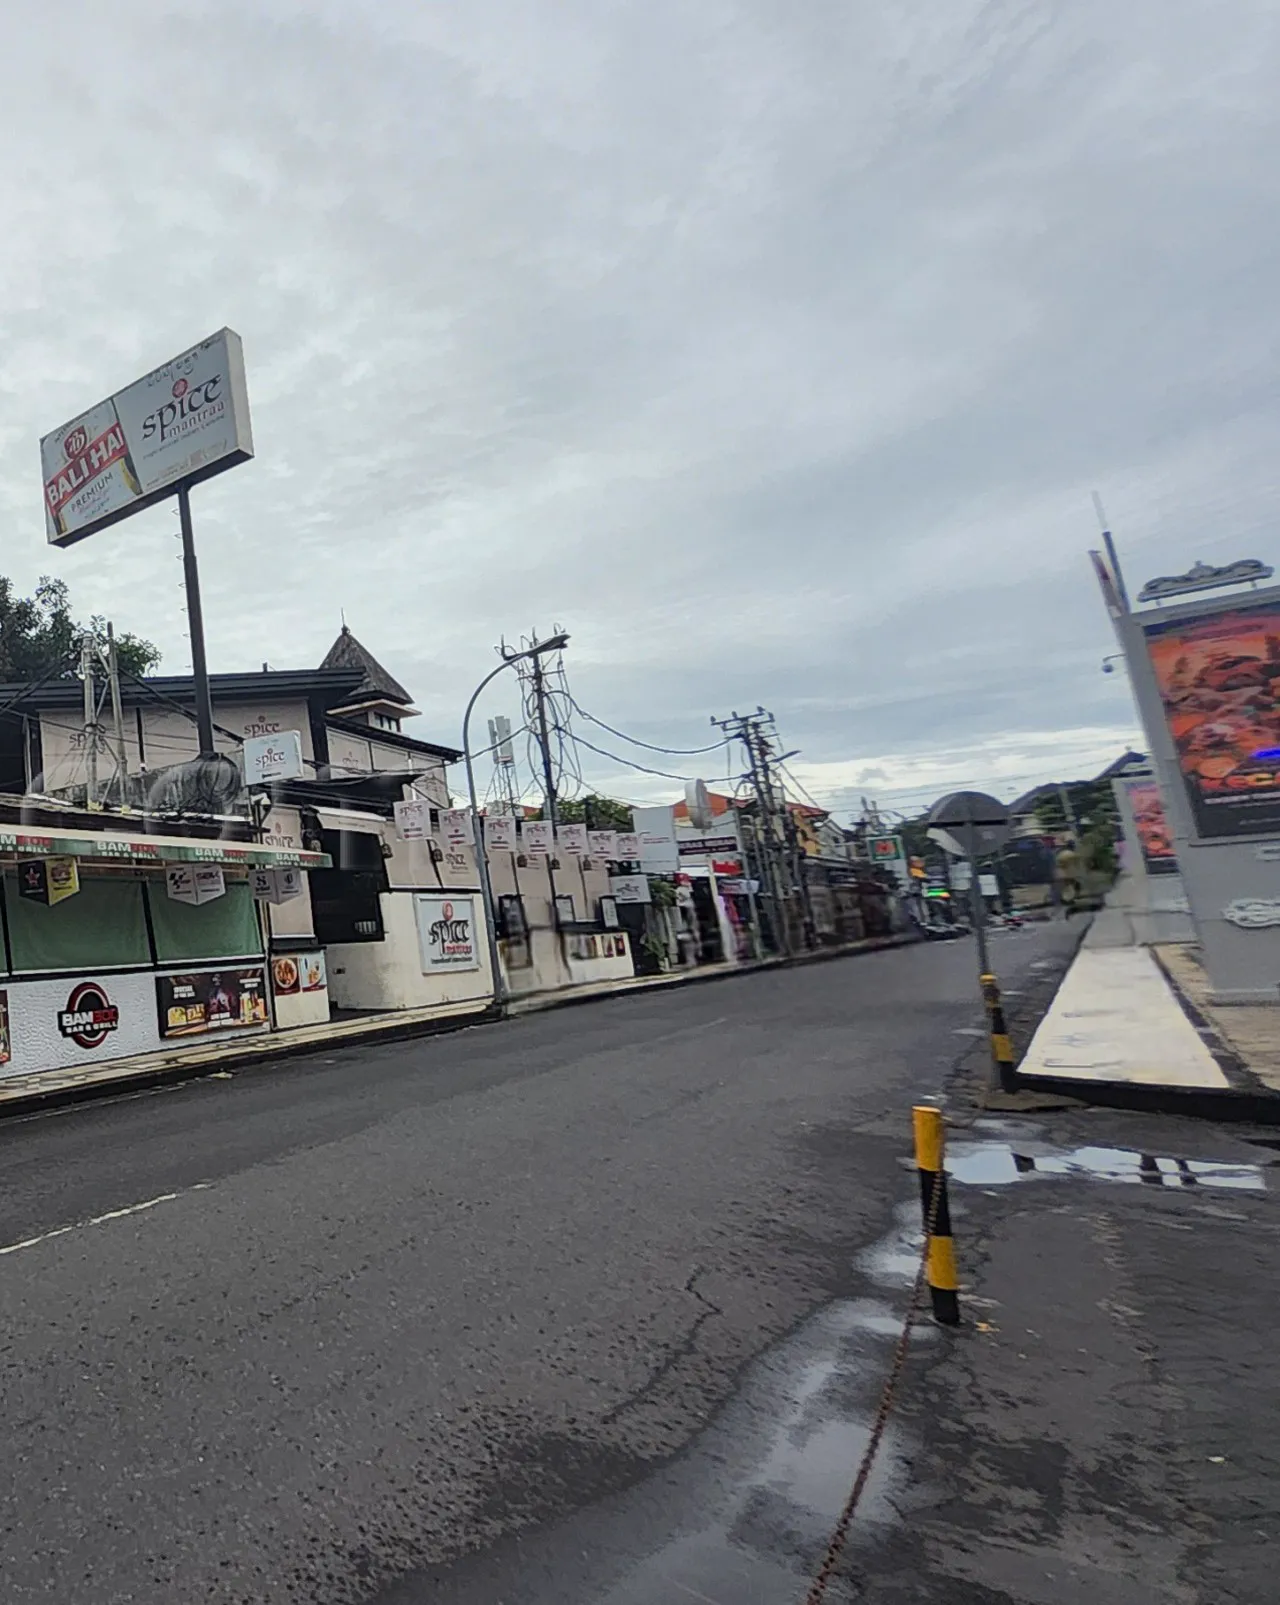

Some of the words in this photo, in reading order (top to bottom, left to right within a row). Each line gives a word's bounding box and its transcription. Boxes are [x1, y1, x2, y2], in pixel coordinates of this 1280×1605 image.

[142, 374, 222, 442] spice
[169, 401, 224, 438] mantraa
[46, 457, 90, 503] BALI
[88, 426, 126, 471] HAI
[70, 473, 113, 512] PREMIUM
[244, 715, 280, 738] spice
[255, 747, 286, 769] spice
[17, 845, 50, 854] GRILL
[428, 901, 470, 956] spice
[62, 1008, 118, 1026] BAMBOO
[66, 1025, 84, 1034] BAR
